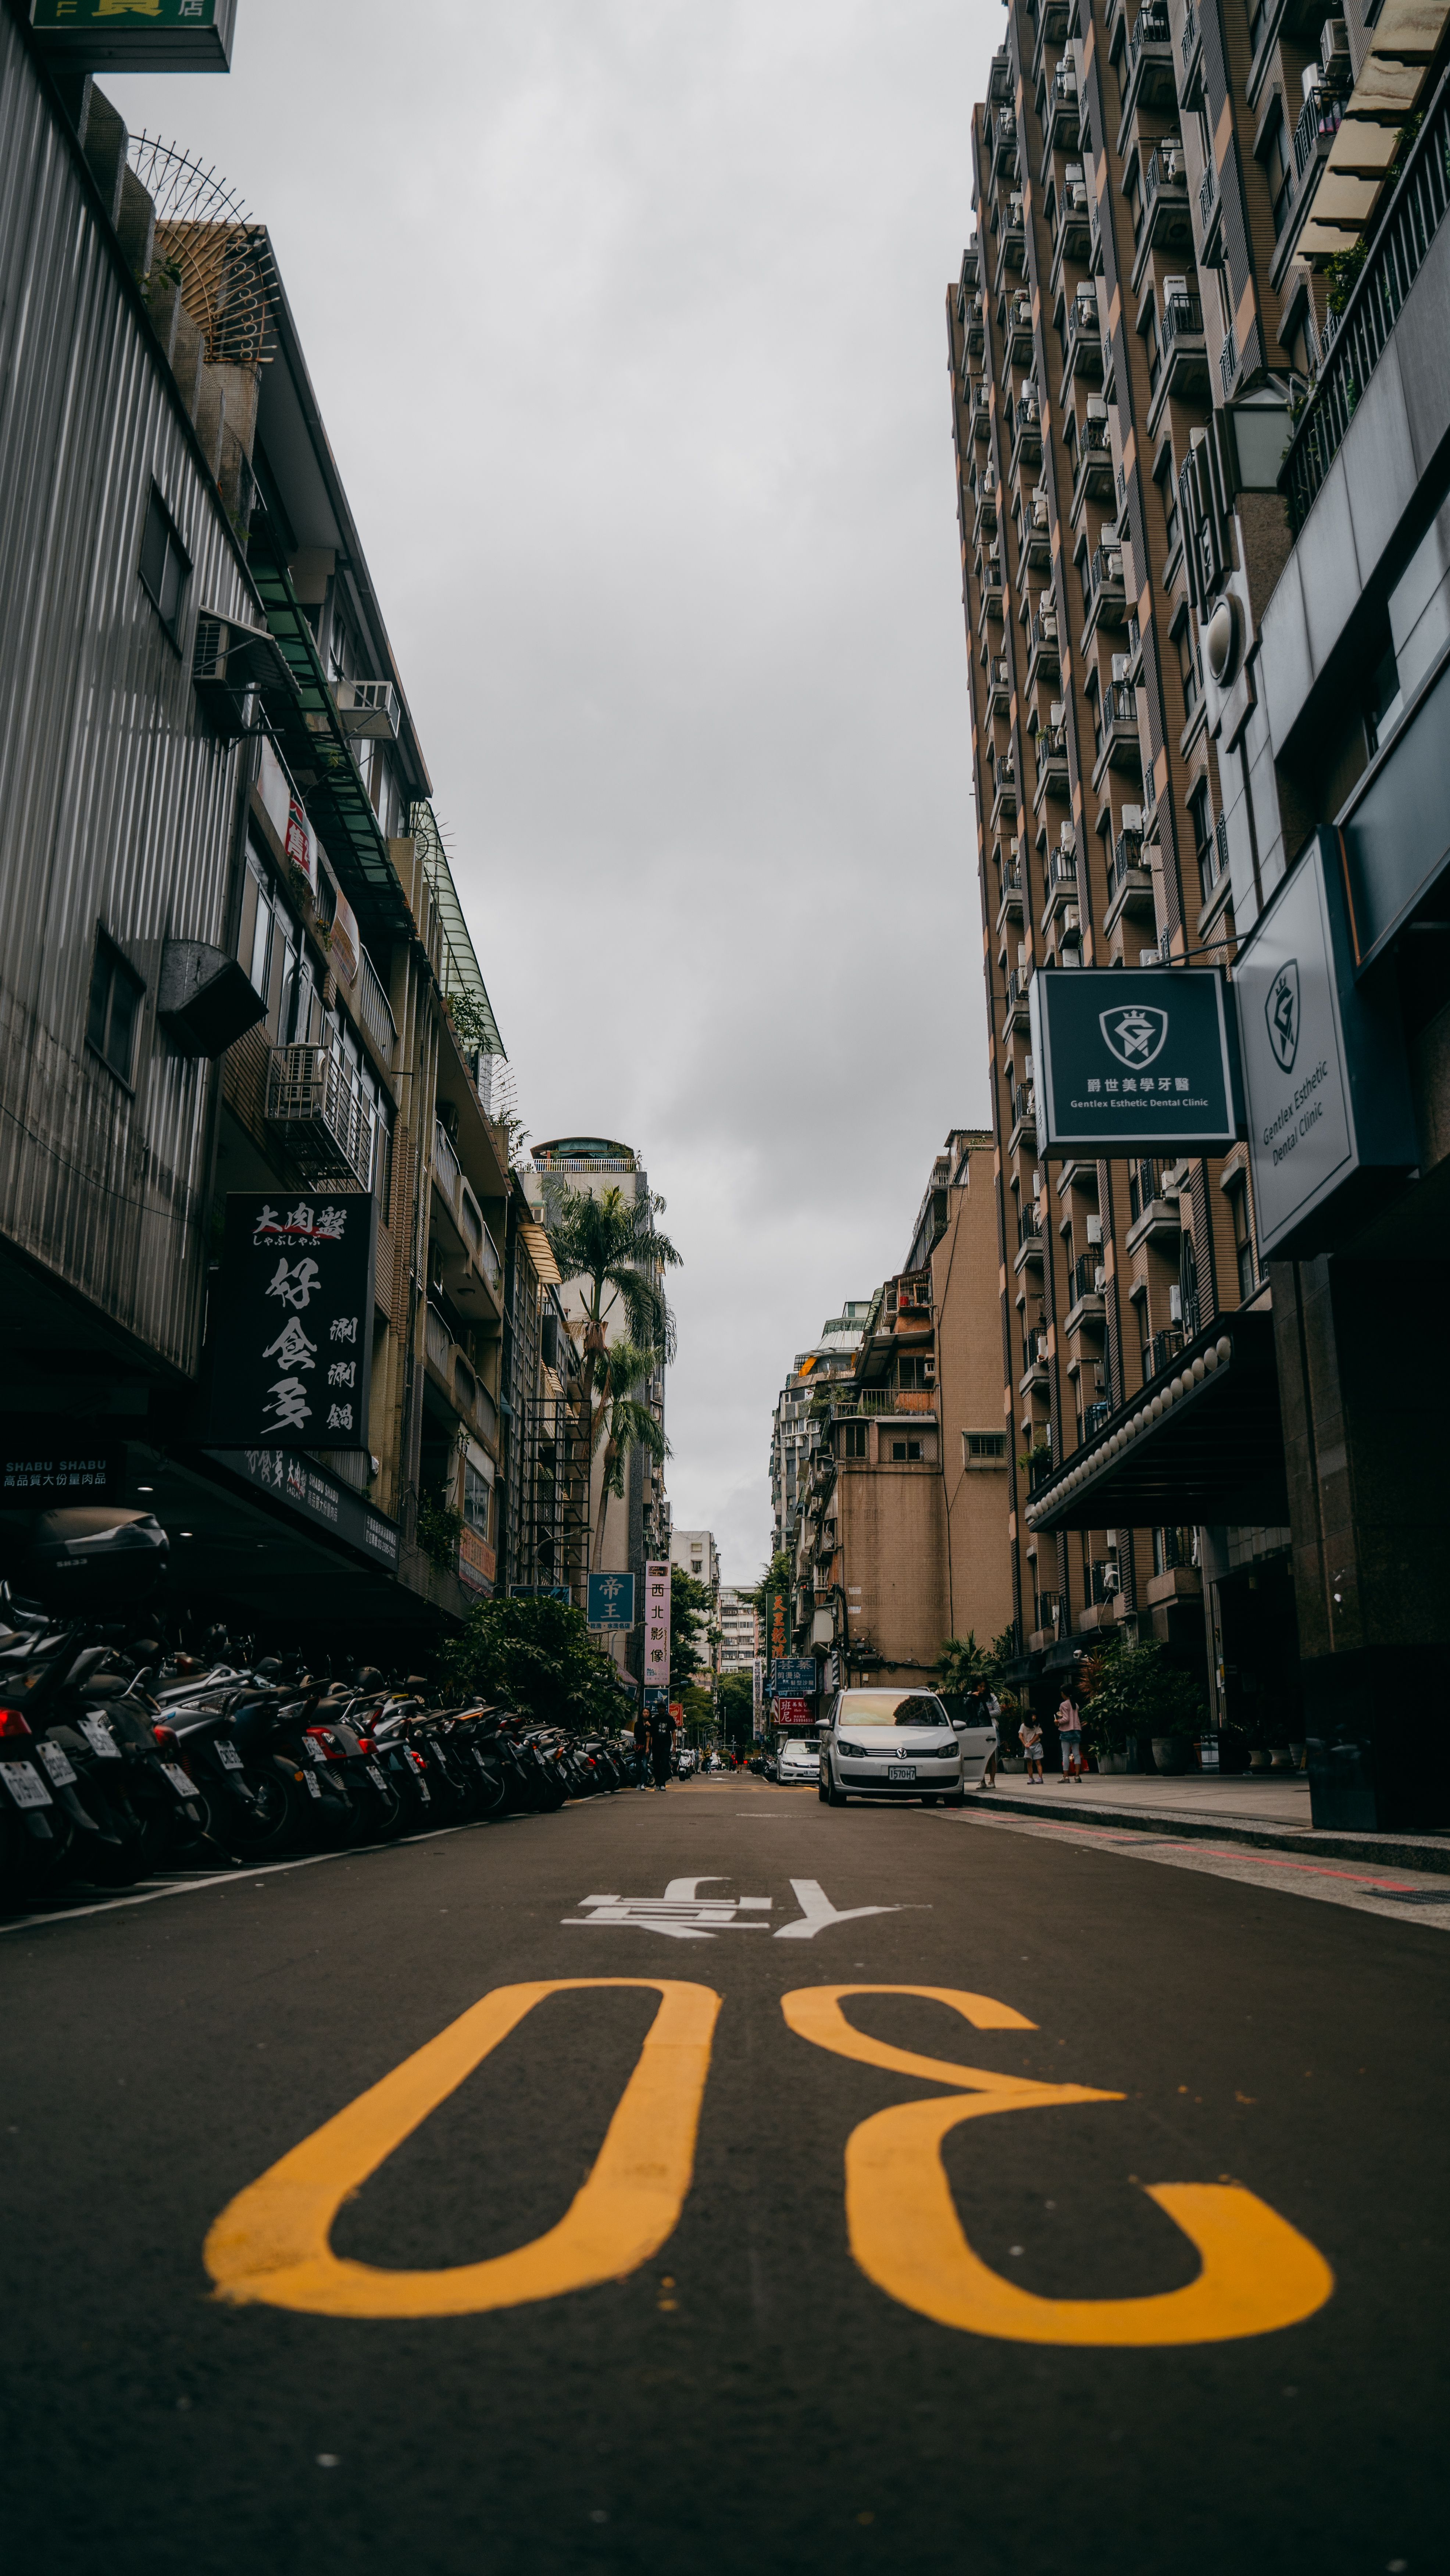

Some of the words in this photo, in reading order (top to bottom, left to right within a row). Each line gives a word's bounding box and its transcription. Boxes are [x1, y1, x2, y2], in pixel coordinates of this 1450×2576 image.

[1087, 1078, 1190, 1092] 爵世美學牙醫
[1111, 1099, 1147, 1107] Esthetic
[1264, 1102, 1293, 1145] Gentlex
[1294, 1060, 1327, 1110] Esthetic
[1273, 1126, 1298, 1167] Dental
[1299, 1102, 1322, 1137] Clinic
[253, 1202, 347, 1239] 大肉盤
[253, 1235, 321, 1246] しゃぶしゃぶ
[260, 1257, 322, 1434] 好食多
[326, 1317, 358, 1430] 涮涮鍋
[4, 1473, 106, 1487] 高品質大份量肉品
[6, 1462, 53, 1471] SHABU
[60, 1460, 106, 1470] SHABU
[309, 1473, 324, 1493] SHABU
[325, 1484, 339, 1504] SHABU
[307, 1490, 338, 1523] 高品質大份量肉品
[599, 1576, 624, 1618] 帝王
[650, 1584, 664, 1663] 西北影像
[781, 1700, 792, 1722] 班尼
[891, 1770, 914, 1778] 1570-H7
[204, 1977, 1335, 2347] 30
